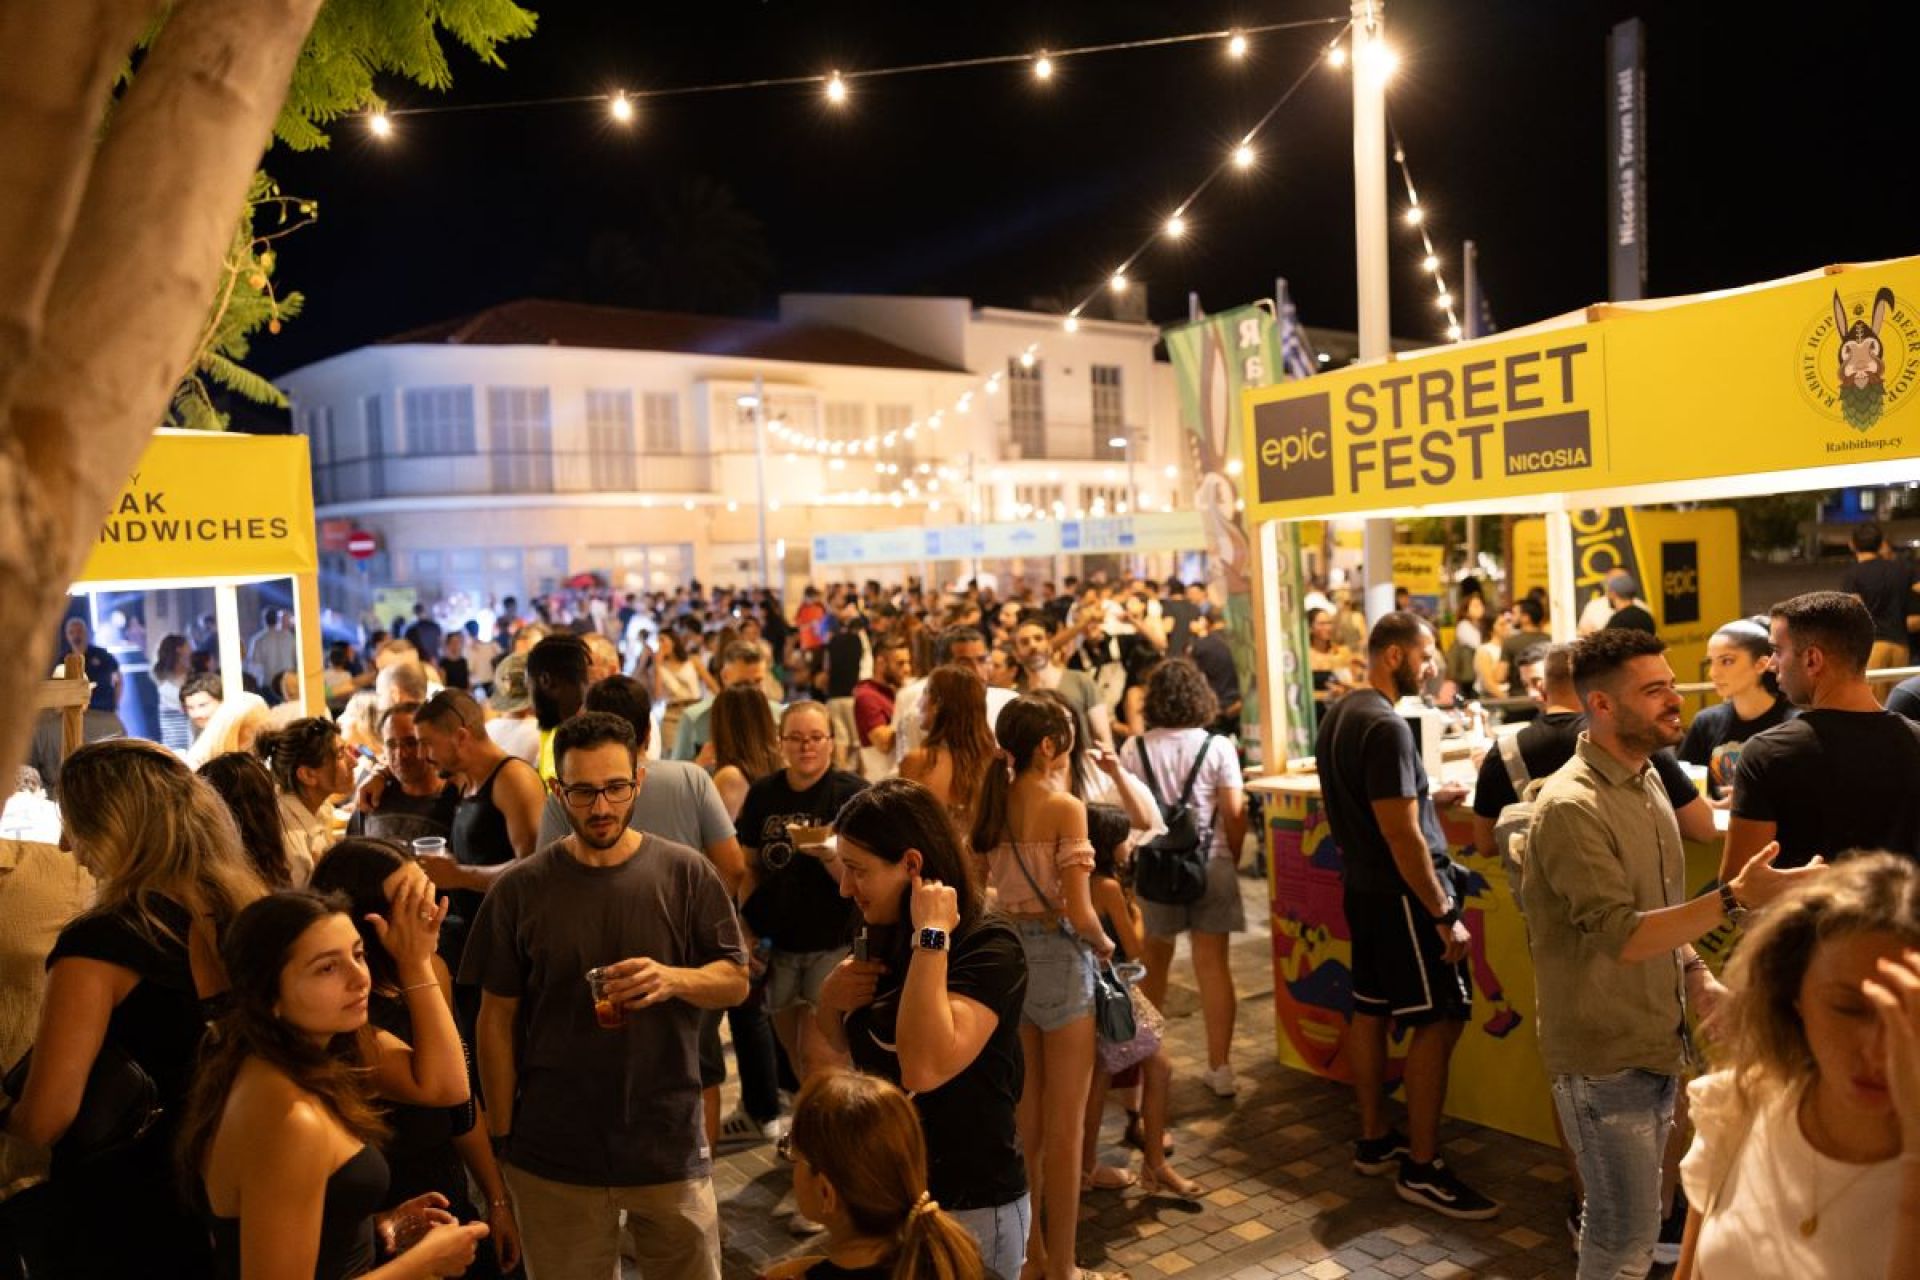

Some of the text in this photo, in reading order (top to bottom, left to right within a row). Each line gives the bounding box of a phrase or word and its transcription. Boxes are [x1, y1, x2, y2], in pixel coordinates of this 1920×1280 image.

[1617, 67, 1635, 246] Nicosia Town Hall
[1803, 315, 1836, 408] RABBIT HOP
[1887, 309, 1920, 404] BEER SHOP
[1345, 342, 1587, 436] STREET
[1261, 427, 1328, 471] epic
[1348, 423, 1494, 494] FEST
[1508, 447, 1588, 473] NICOSIA
[100, 516, 289, 544] NDWICHES
[110, 491, 167, 515] AK
[1663, 565, 1698, 599] epic
